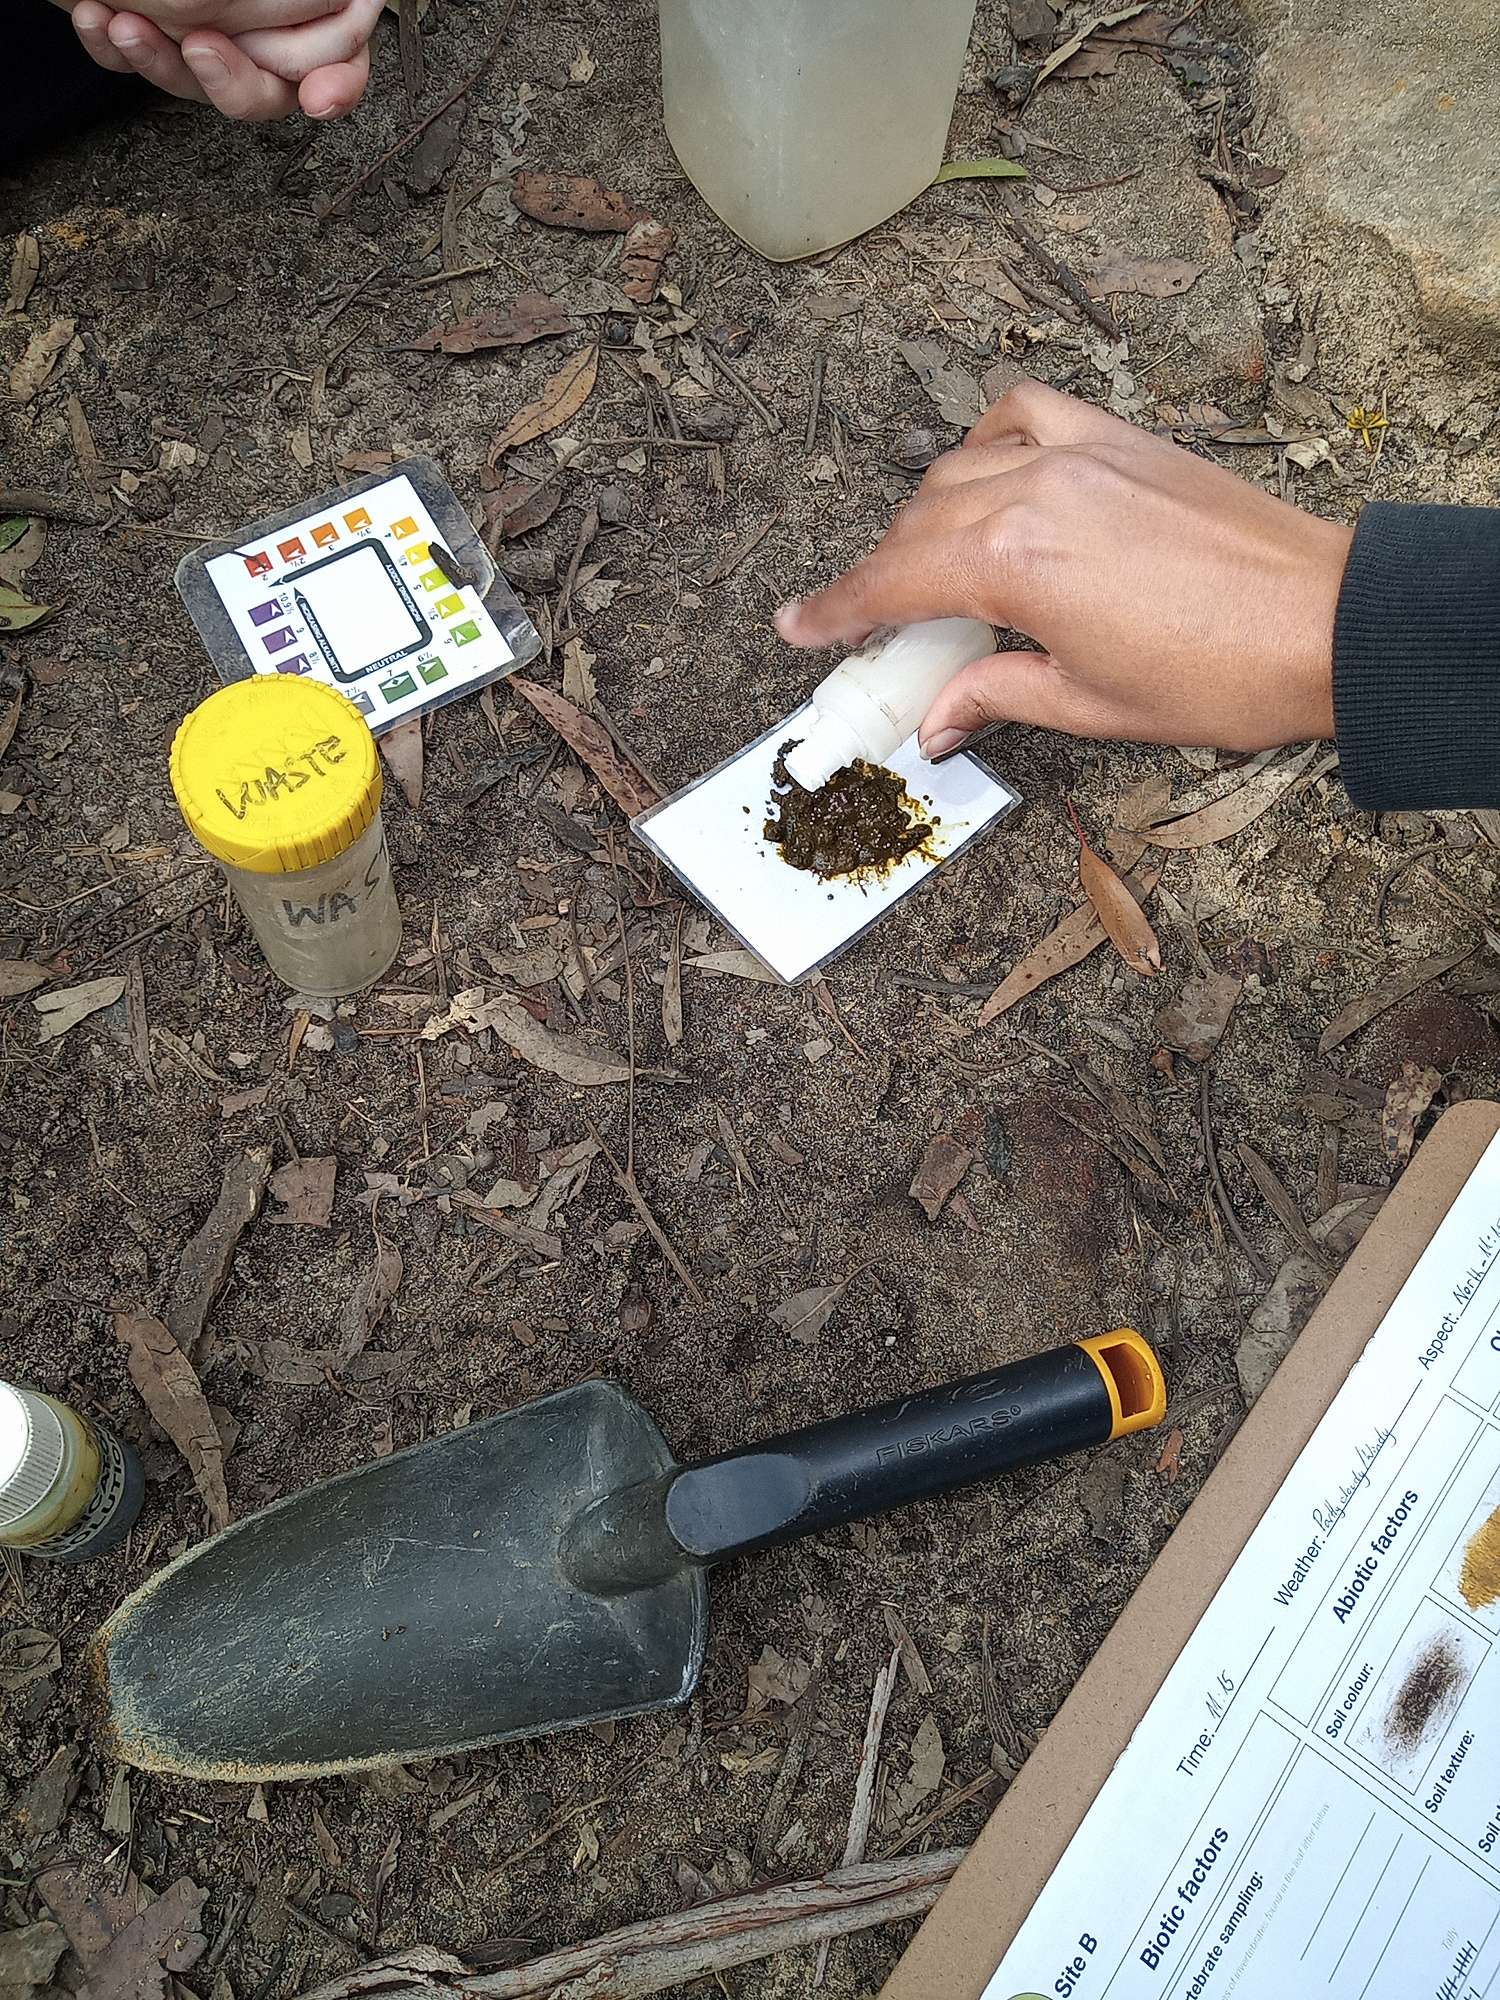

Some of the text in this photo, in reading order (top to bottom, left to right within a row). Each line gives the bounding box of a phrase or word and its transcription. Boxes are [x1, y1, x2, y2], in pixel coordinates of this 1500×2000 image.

[365, 650, 408, 674] NEUTRAL
[387, 669, 393, 677] 7
[215, 735, 347, 820] WASTE
[1418, 1312, 1459, 1370] Aspect:
[1273, 1534, 1327, 1606] Weather:
[1333, 1489, 1418, 1624] Abiotic factors
[1325, 1711, 1348, 1738] Soil
[1344, 1663, 1374, 1711] colour:
[1176, 1728, 1215, 1777] Time:
[1424, 1729, 1475, 1813] Soil texture:
[1478, 1821, 1500, 1853] Soil
[1140, 1827, 1229, 1970] Biotic factors
[1220, 1871, 1263, 1944] sampling:
[1055, 1933, 1098, 2000] Site B
